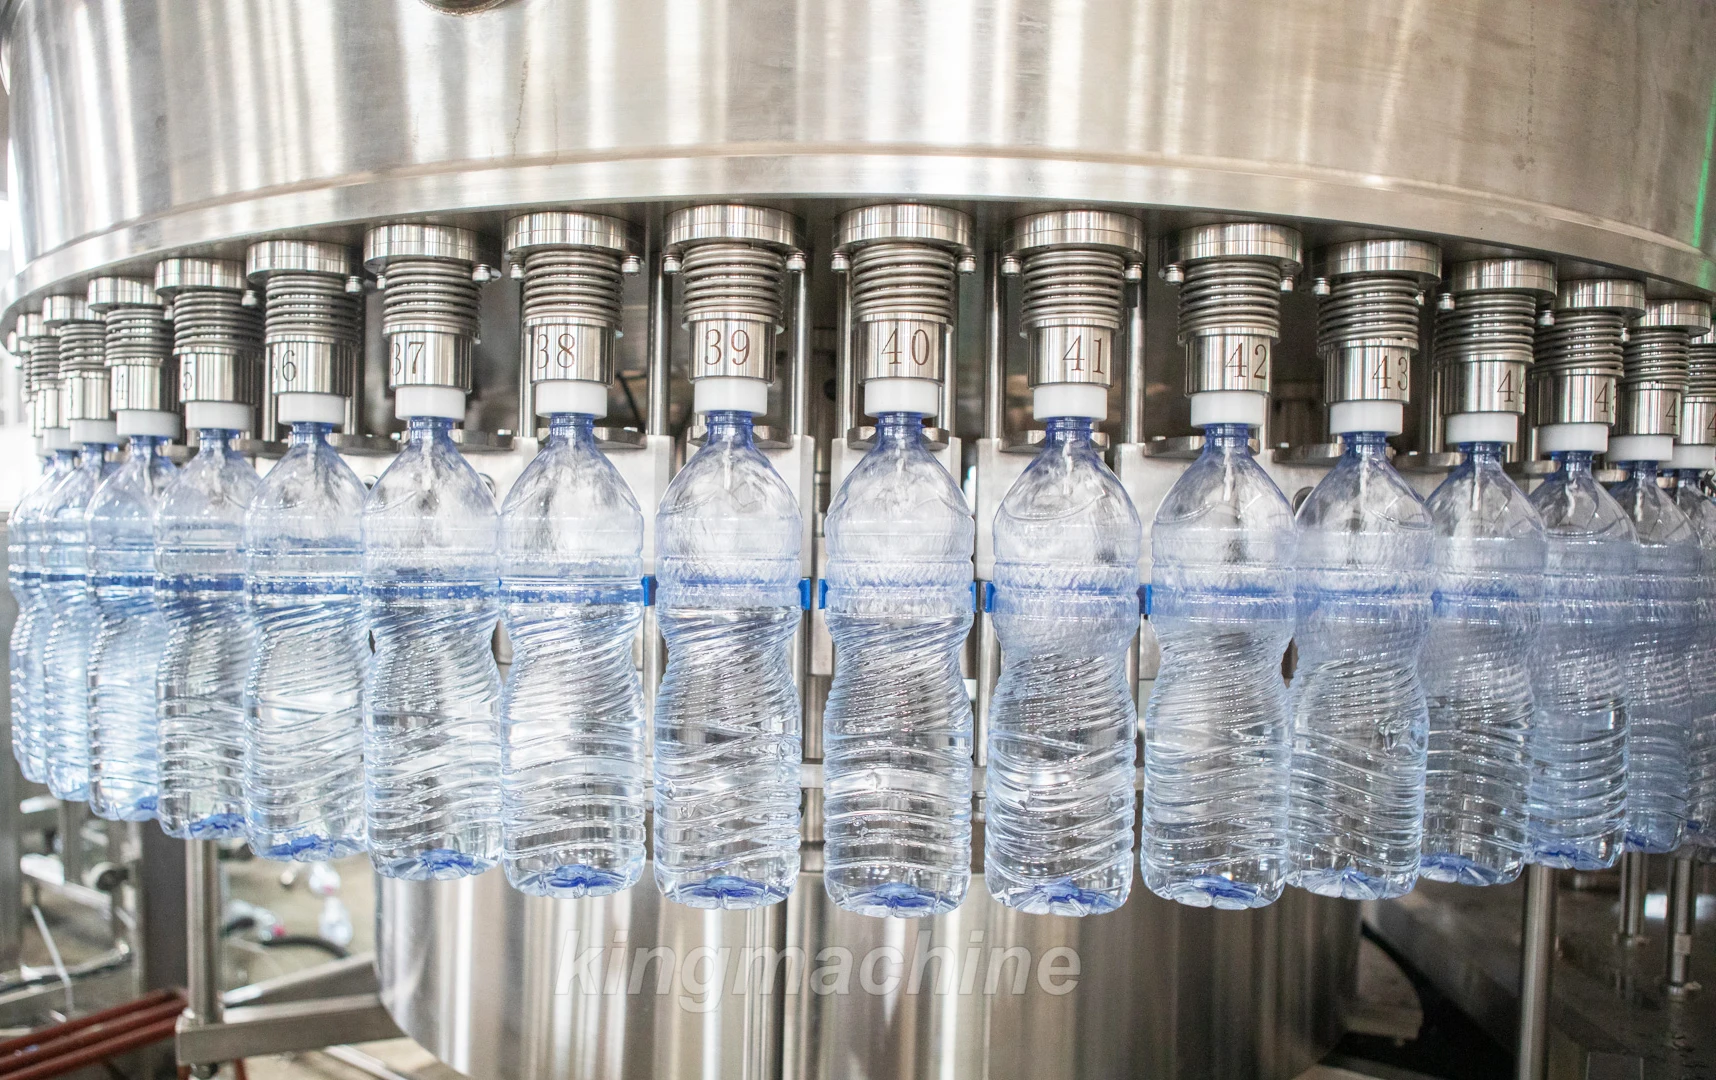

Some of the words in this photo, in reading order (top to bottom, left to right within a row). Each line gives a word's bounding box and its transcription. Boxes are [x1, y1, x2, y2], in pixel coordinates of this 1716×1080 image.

[391, 341, 425, 376] 37
[536, 333, 575, 370] 38
[704, 328, 751, 366] 39
[881, 328, 930, 366] 40
[1062, 334, 1104, 375] 41
[1225, 342, 1267, 380] 42
[1372, 355, 1408, 391] 43
